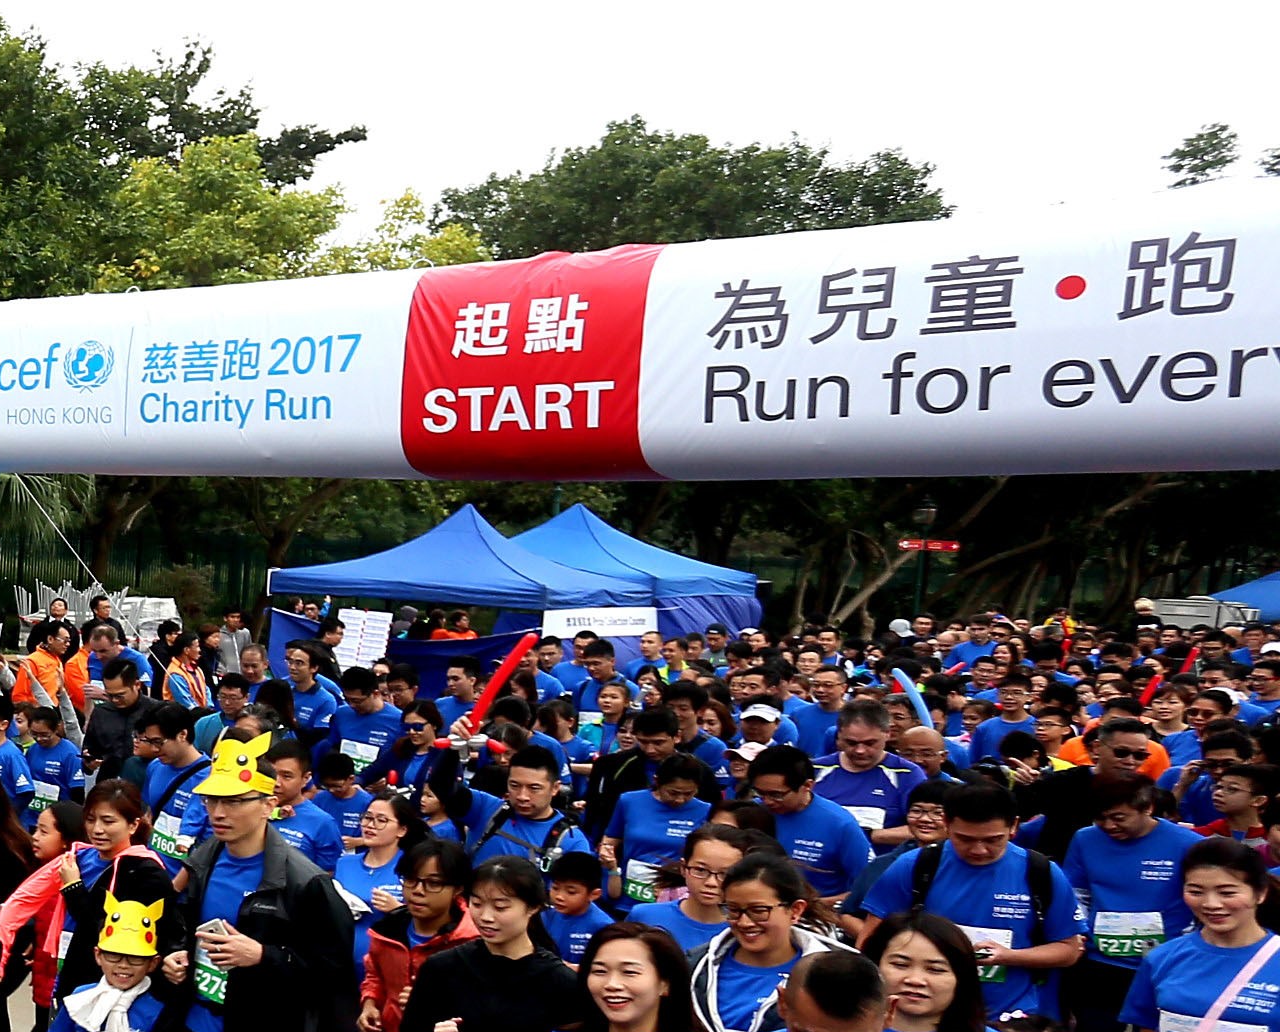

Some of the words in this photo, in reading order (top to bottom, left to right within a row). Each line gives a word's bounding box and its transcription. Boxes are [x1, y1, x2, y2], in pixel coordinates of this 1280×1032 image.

[451, 293, 589, 358] 起點
[423, 379, 616, 434] START
[703, 364, 850, 425] Run
[887, 351, 1012, 416] for
[1042, 343, 1280, 411] ever
[6, 405, 51, 426] HONG
[58, 404, 112, 426] KONG
[139, 390, 252, 429] Charity
[267, 391, 332, 422] Run
[994, 892, 1020, 901] unicef
